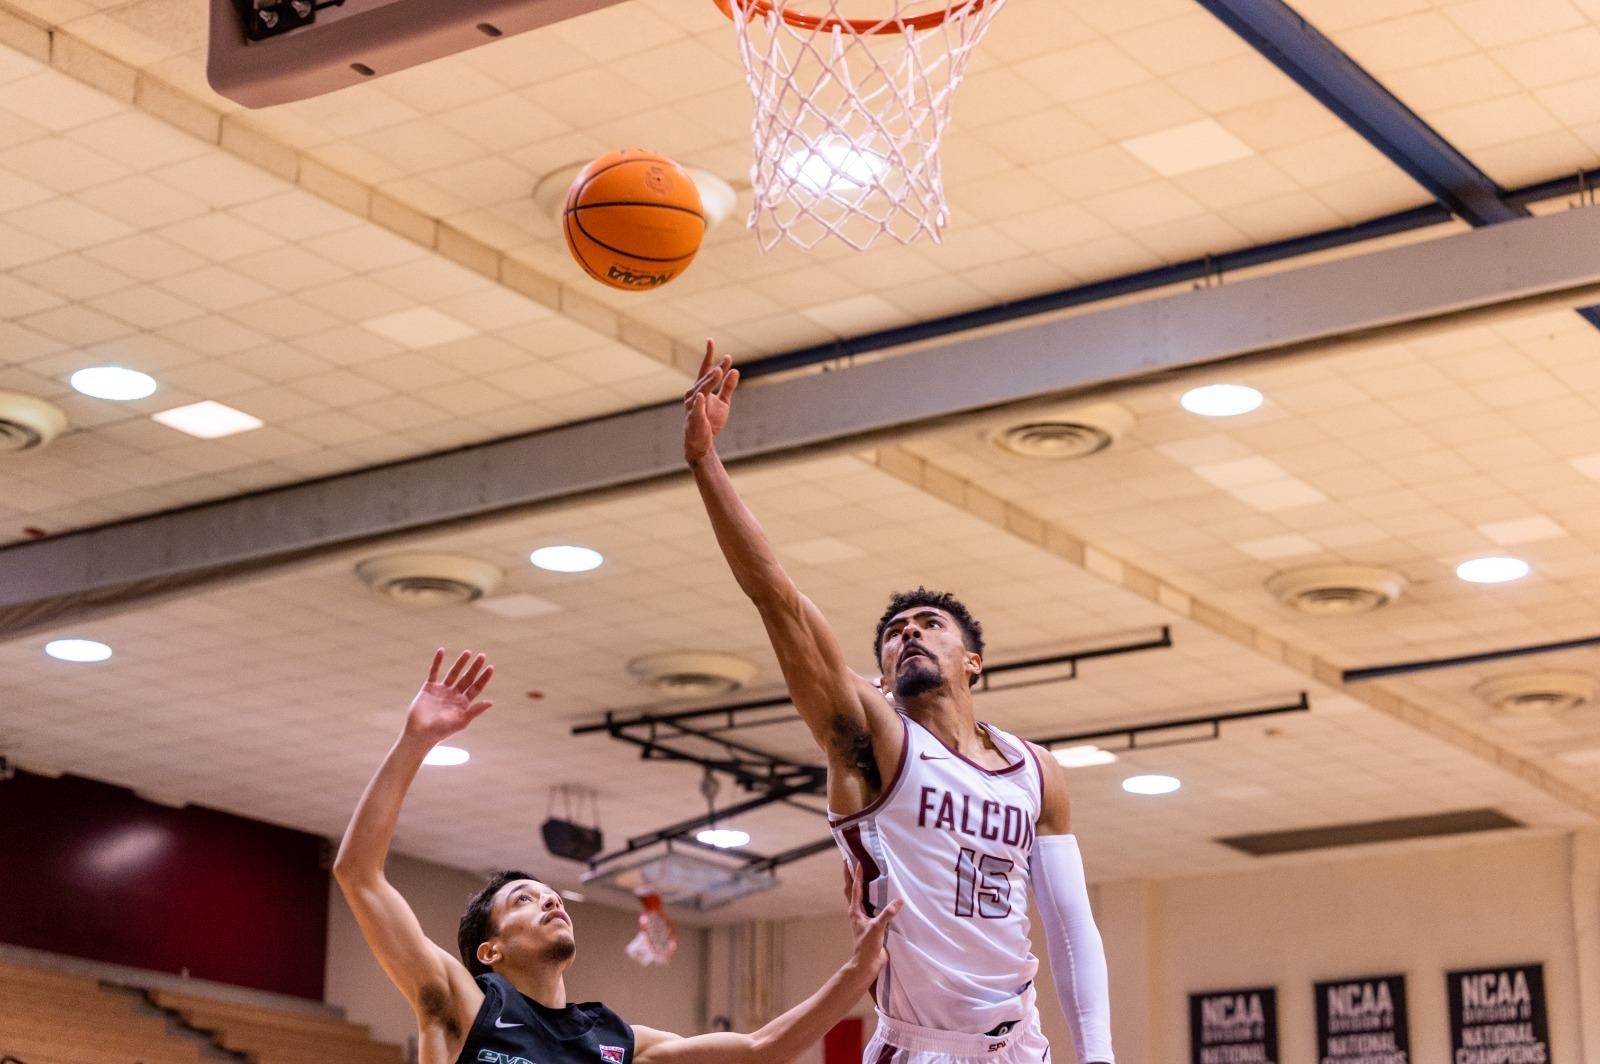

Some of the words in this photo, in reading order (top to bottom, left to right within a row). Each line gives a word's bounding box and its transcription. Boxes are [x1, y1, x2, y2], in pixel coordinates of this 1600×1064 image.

[955, 847, 1014, 918] 15
[1327, 981, 1392, 1017] NCAA
[1461, 970, 1531, 1007] NCAA
[1201, 994, 1264, 1028] NCAA
[1462, 1022, 1537, 1047] NATIONAL
